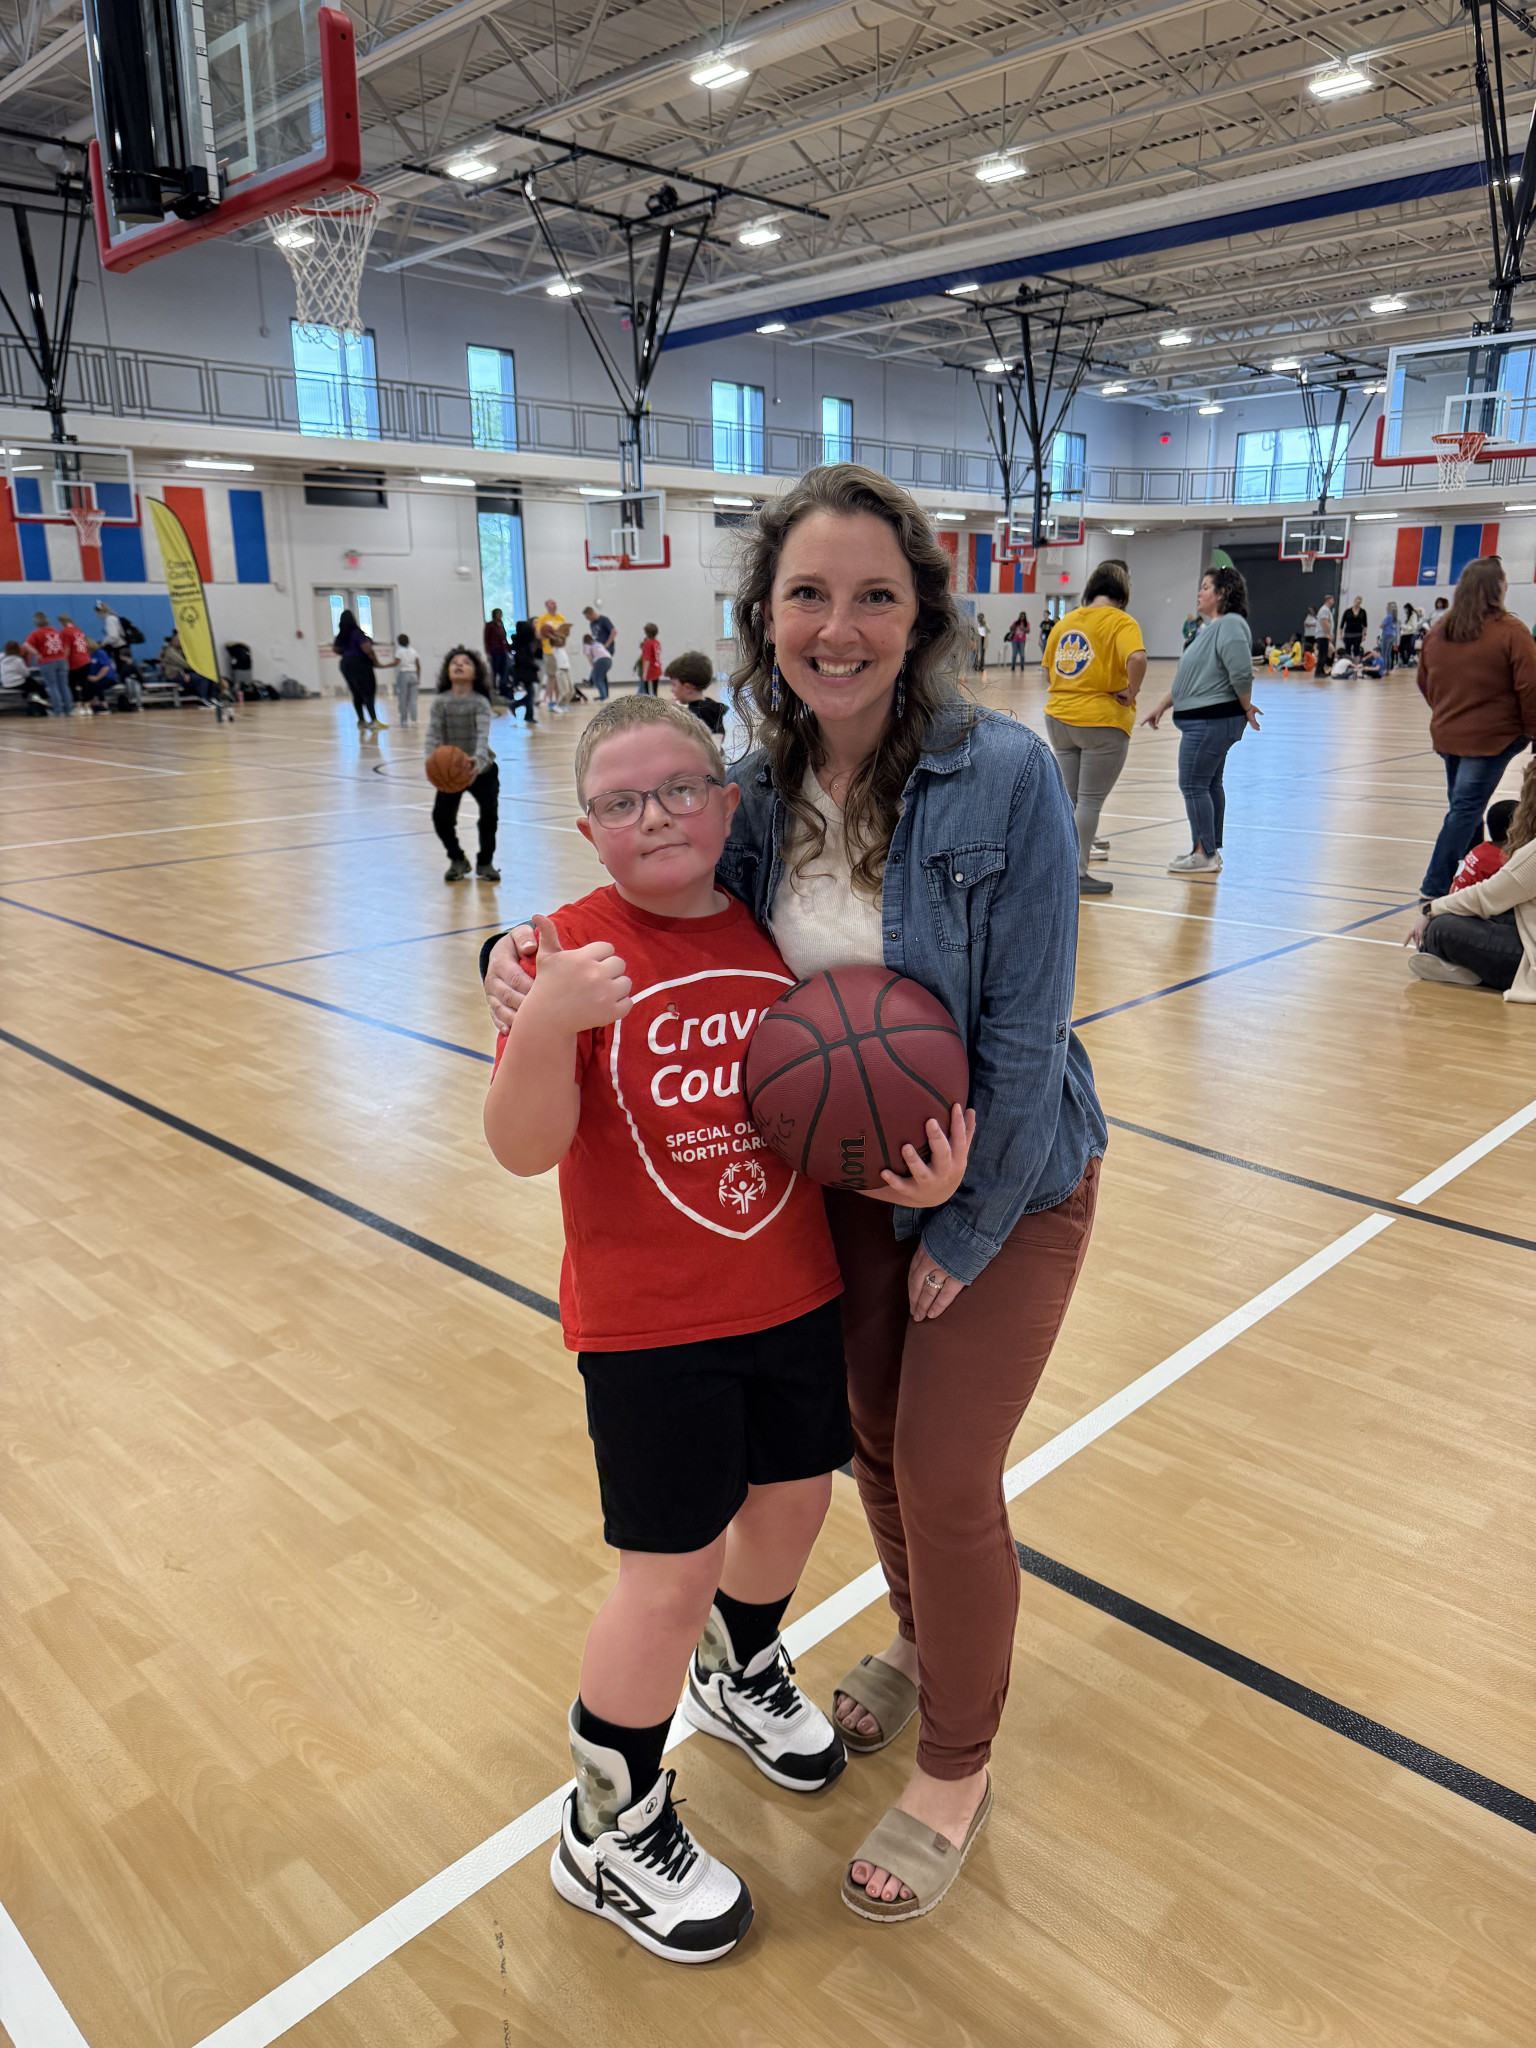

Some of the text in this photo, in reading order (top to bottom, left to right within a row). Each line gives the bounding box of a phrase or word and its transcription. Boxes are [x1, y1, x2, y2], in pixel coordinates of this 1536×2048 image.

[651, 1061, 740, 1107] Cou
[665, 1120, 757, 1148] SPECIAL OL
[671, 1142, 729, 1163] NORTH
